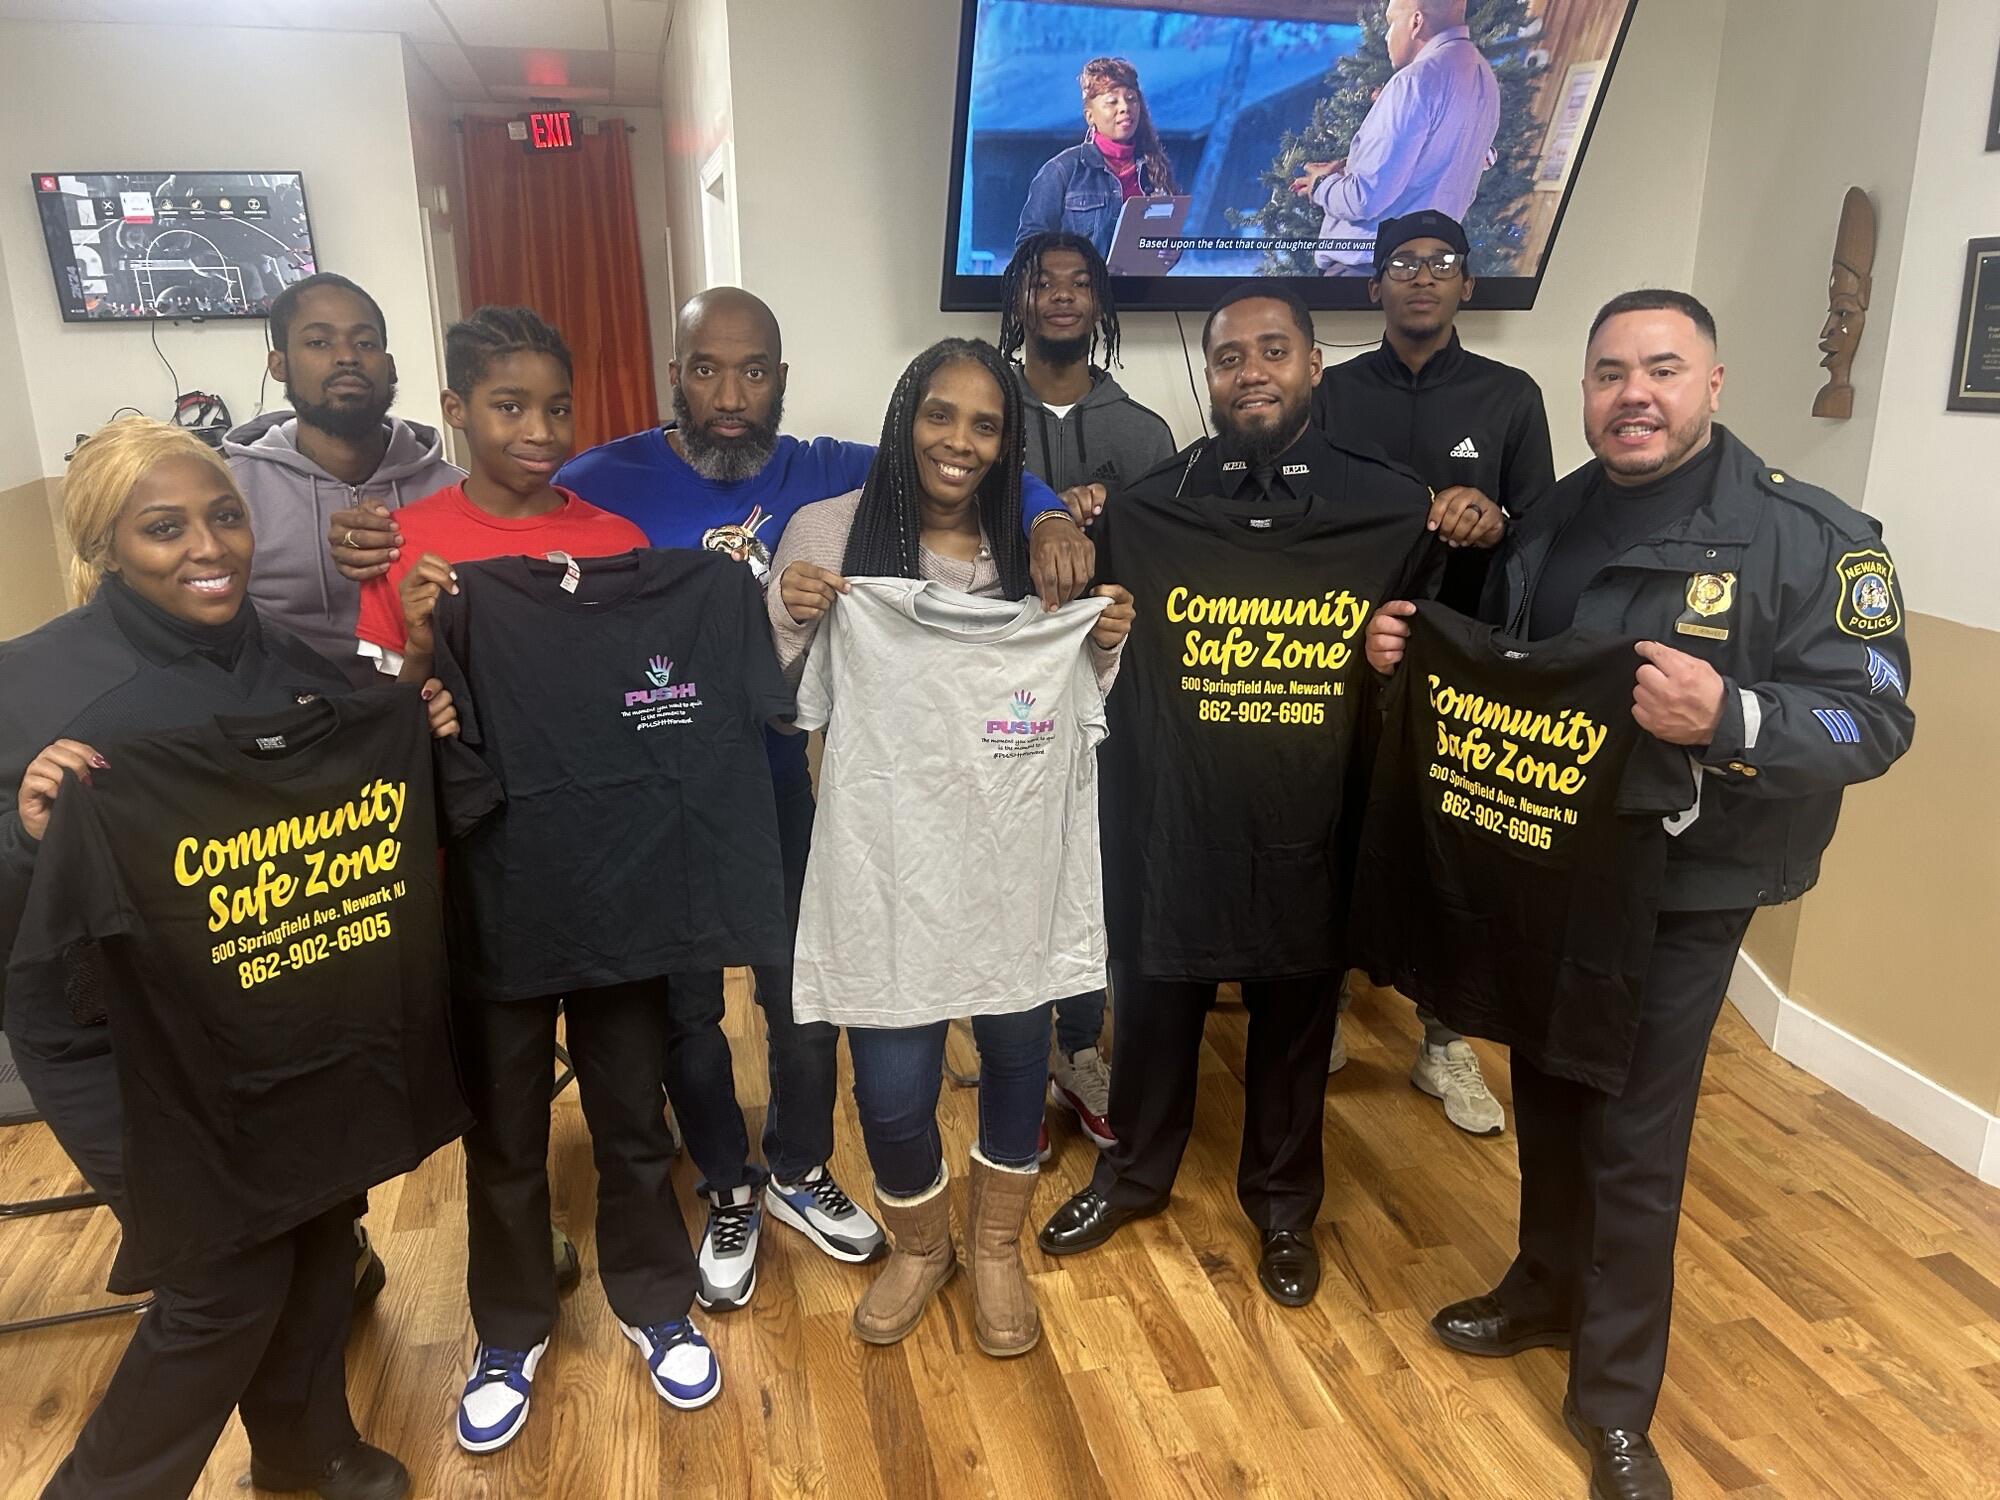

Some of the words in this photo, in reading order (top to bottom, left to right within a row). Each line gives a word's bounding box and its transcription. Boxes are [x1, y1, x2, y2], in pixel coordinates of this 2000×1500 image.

[530, 112, 572, 148] EXIT
[1139, 238, 1169, 249] Based
[1170, 241, 1195, 251] upon
[1197, 239, 1213, 249] the
[1215, 239, 1233, 249] fact
[1235, 239, 1254, 249] that
[1256, 241, 1273, 249] our
[1275, 240, 1317, 252] daughter
[1318, 240, 1333, 250] did
[1335, 241, 1351, 250] not
[1353, 241, 1376, 250] want
[1450, 450, 1479, 459] adidas
[1845, 561, 1887, 580] NEWARK
[1166, 587, 1370, 640] Community
[1849, 615, 1893, 630] POLICE
[1182, 627, 1259, 675] Safe
[1262, 631, 1351, 670] Zone
[624, 683, 696, 707] PUSHH
[1181, 676, 1201, 691] 500
[1202, 679, 1262, 696] Springfield
[1264, 680, 1287, 695] Ave.
[1289, 680, 1331, 696] Newark
[1333, 681, 1345, 696] NJ
[632, 707, 655, 716] moment
[656, 705, 668, 713] you
[986, 719, 1055, 735] PUSHH
[1199, 699, 1325, 725] 862-902-6905
[1437, 720, 1496, 772] Safe
[1496, 739, 1587, 795] Zone
[1449, 771, 1495, 801] Springfield
[1496, 789, 1518, 810] Ave.
[1519, 797, 1561, 821] Newark
[1563, 808, 1578, 825] NJ
[174, 778, 406, 887] Community
[1441, 790, 1553, 850] 862-902-6905
[208, 861, 299, 933] Safe
[305, 838, 401, 897] Zone
[211, 940, 236, 965] 500
[238, 913, 310, 954] Springfield
[313, 907, 341, 926] Ave.
[342, 886, 392, 915] Newark
[394, 880, 406, 900] NJ
[239, 912, 391, 989] 862-902-6905
